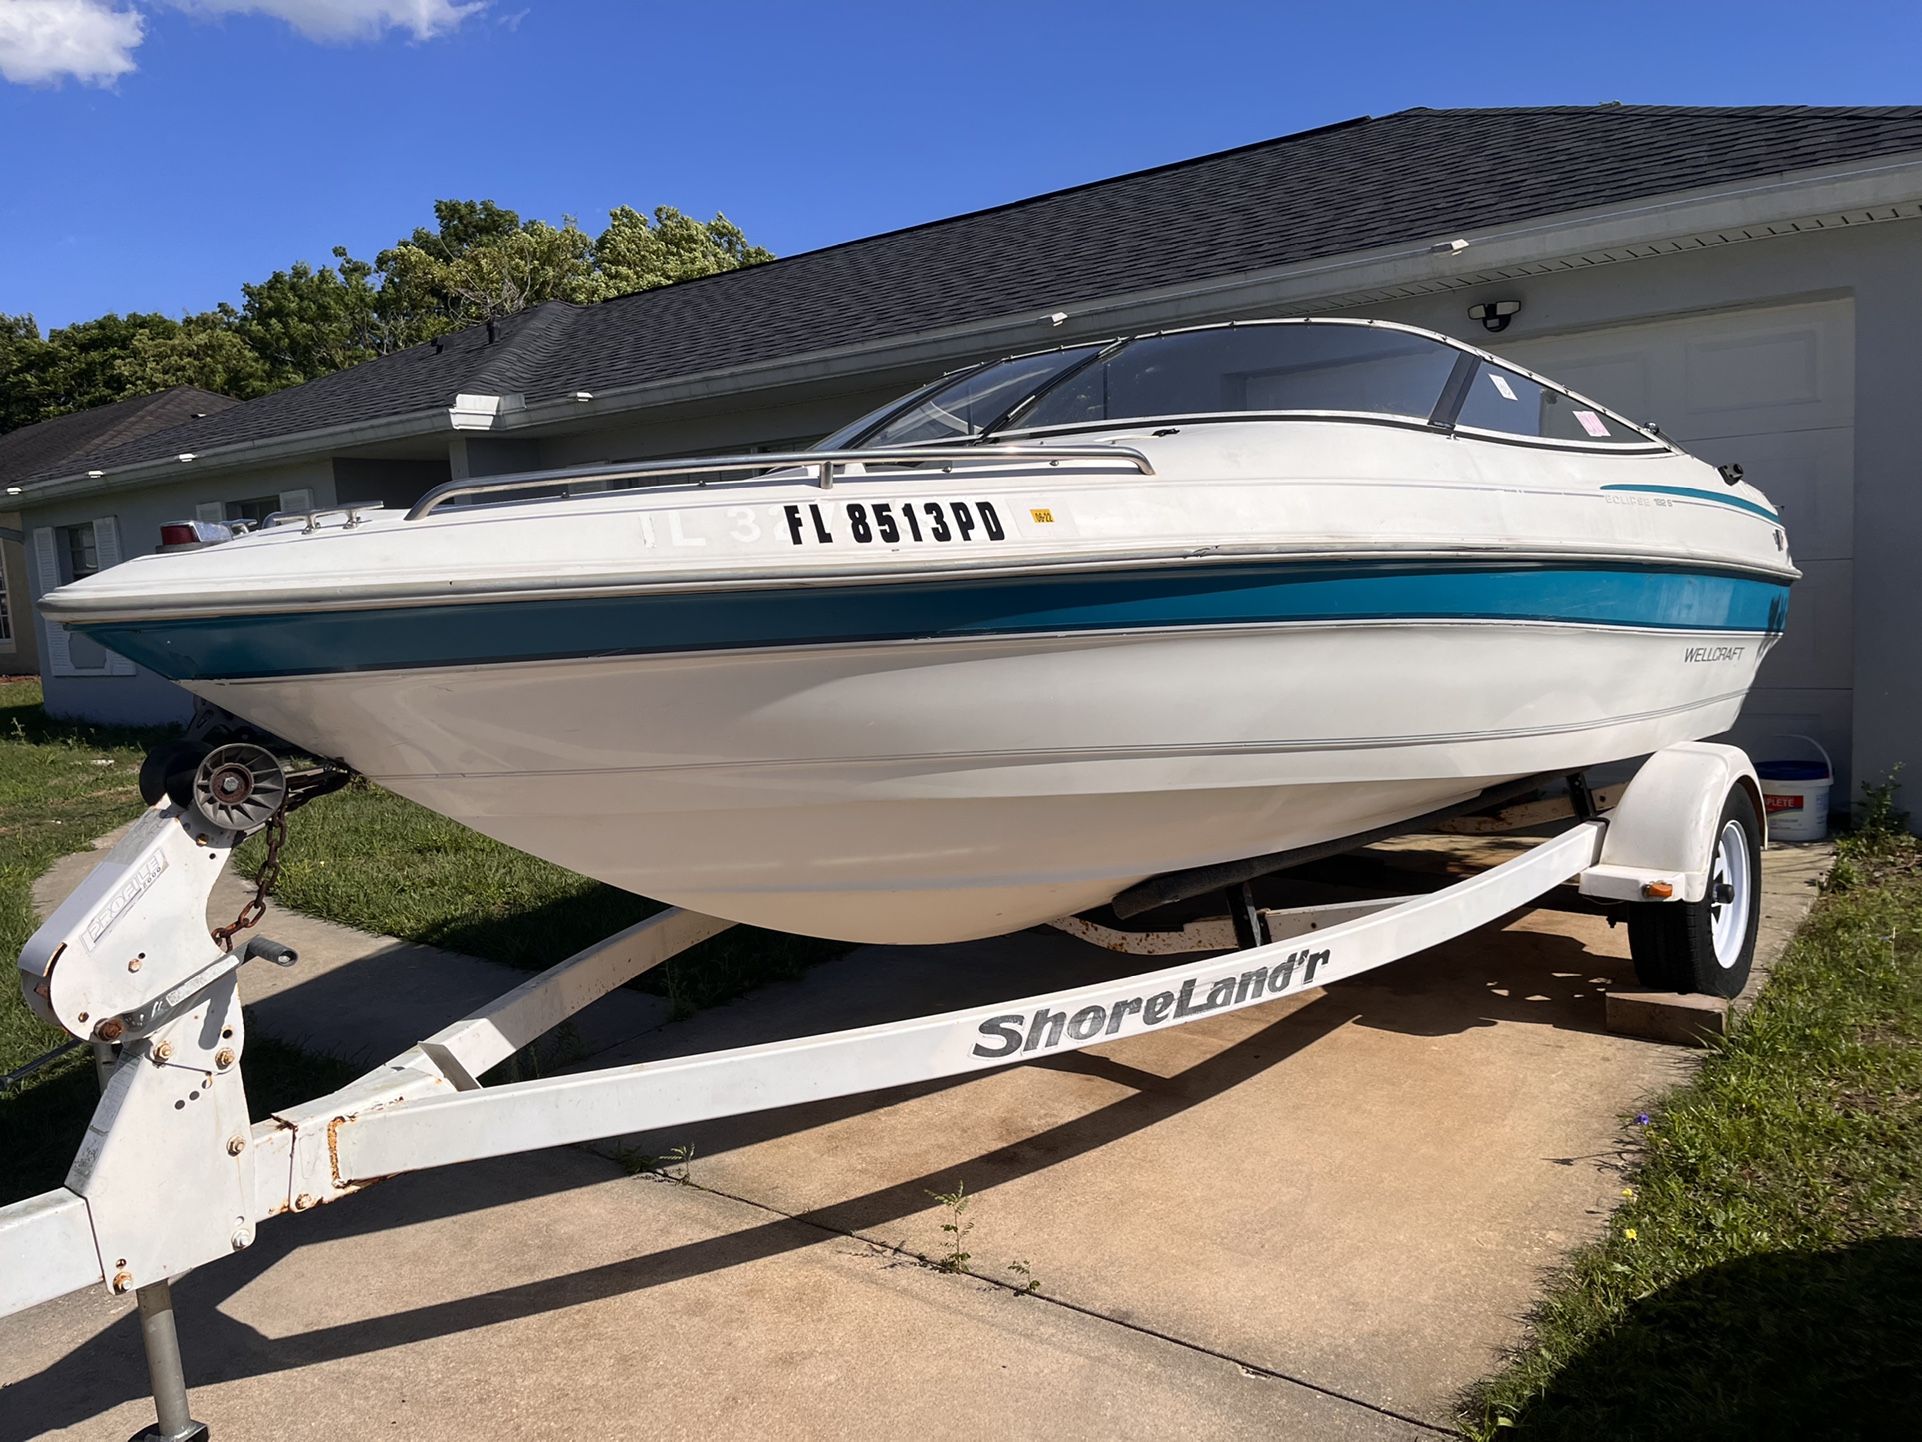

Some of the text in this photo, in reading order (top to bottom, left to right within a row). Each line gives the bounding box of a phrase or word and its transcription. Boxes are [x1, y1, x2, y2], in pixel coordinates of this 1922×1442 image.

[783, 501, 1005, 545] FL 8513PD
[1684, 646, 1745, 663] WELLCRAFT
[1766, 797, 1795, 808] PLETE
[86, 853, 161, 942] PROFILE
[972, 948, 1331, 1058] ShoreLand'r
